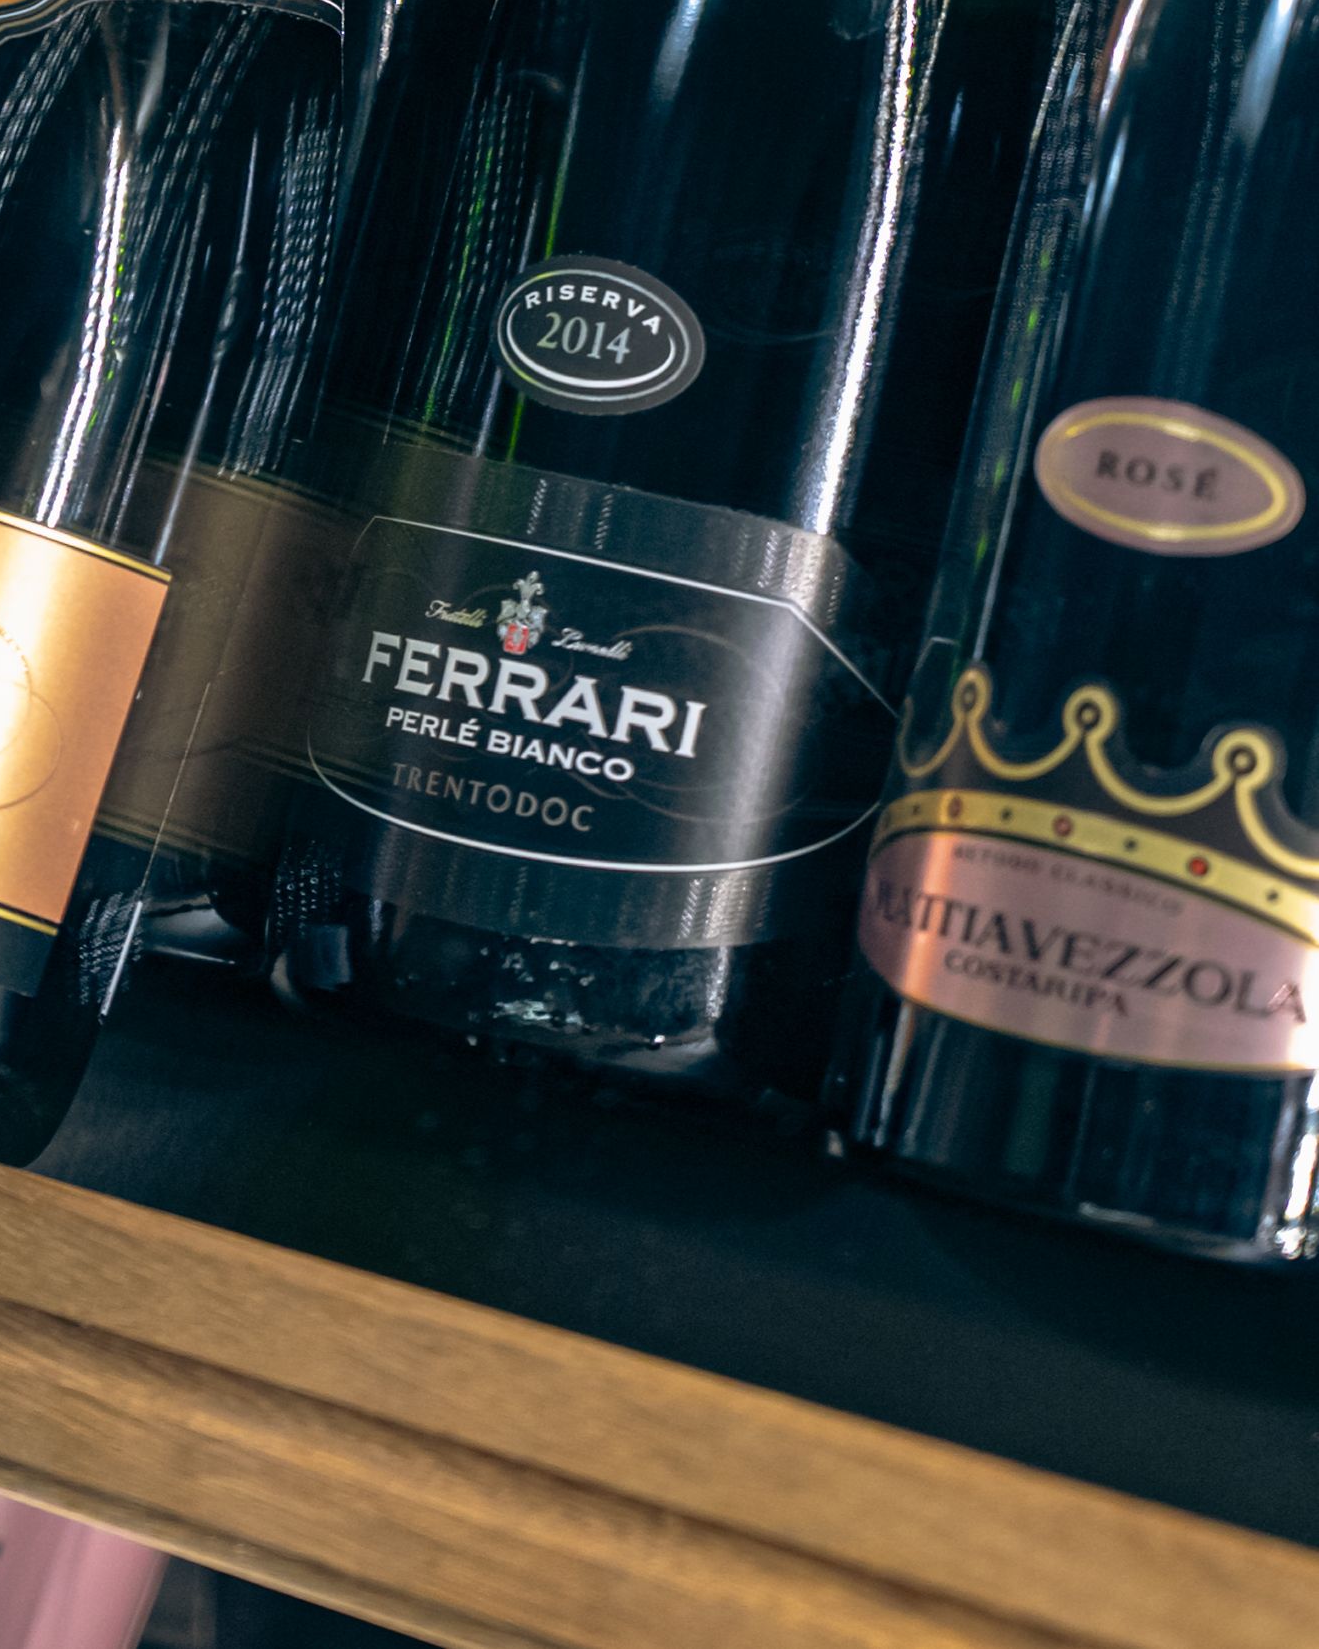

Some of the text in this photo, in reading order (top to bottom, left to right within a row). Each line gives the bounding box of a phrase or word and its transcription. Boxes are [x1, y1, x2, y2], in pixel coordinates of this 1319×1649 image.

[524, 284, 662, 336] RISERVA
[536, 311, 631, 365] 2014
[361, 630, 708, 759] FERRARI
[385, 706, 635, 783] PERLÉ BIANCO
[391, 761, 596, 832] TRENTODOC
